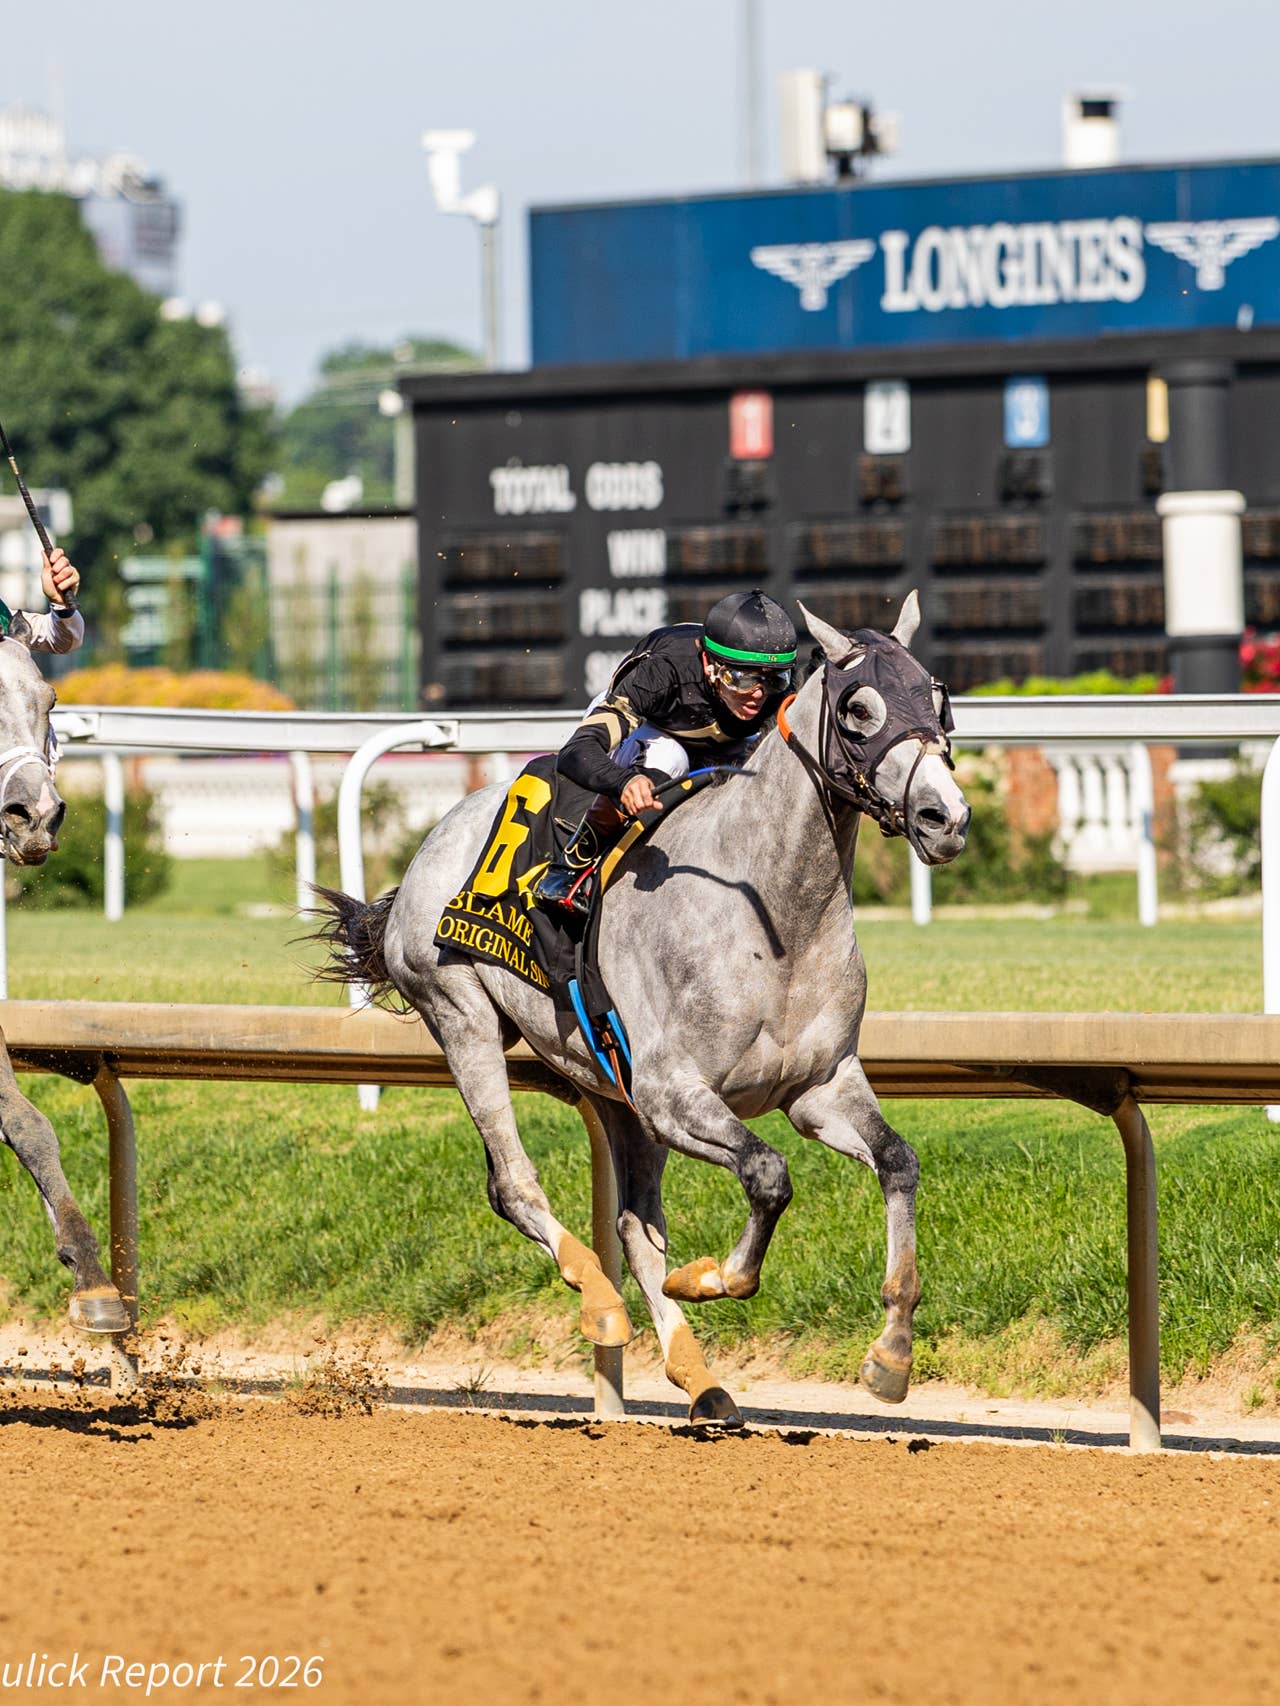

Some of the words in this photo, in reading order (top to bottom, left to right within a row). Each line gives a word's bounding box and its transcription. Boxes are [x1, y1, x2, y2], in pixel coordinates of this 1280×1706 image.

[879, 215, 1146, 312] LONGINES
[1013, 382, 1041, 440] 3
[490, 464, 577, 515] TOTAL
[585, 461, 664, 511] ODDS
[607, 528, 666, 578] WIN
[579, 588, 669, 637] PLACE
[473, 774, 552, 897] 6
[436, 915, 529, 977] ORIGINAL
